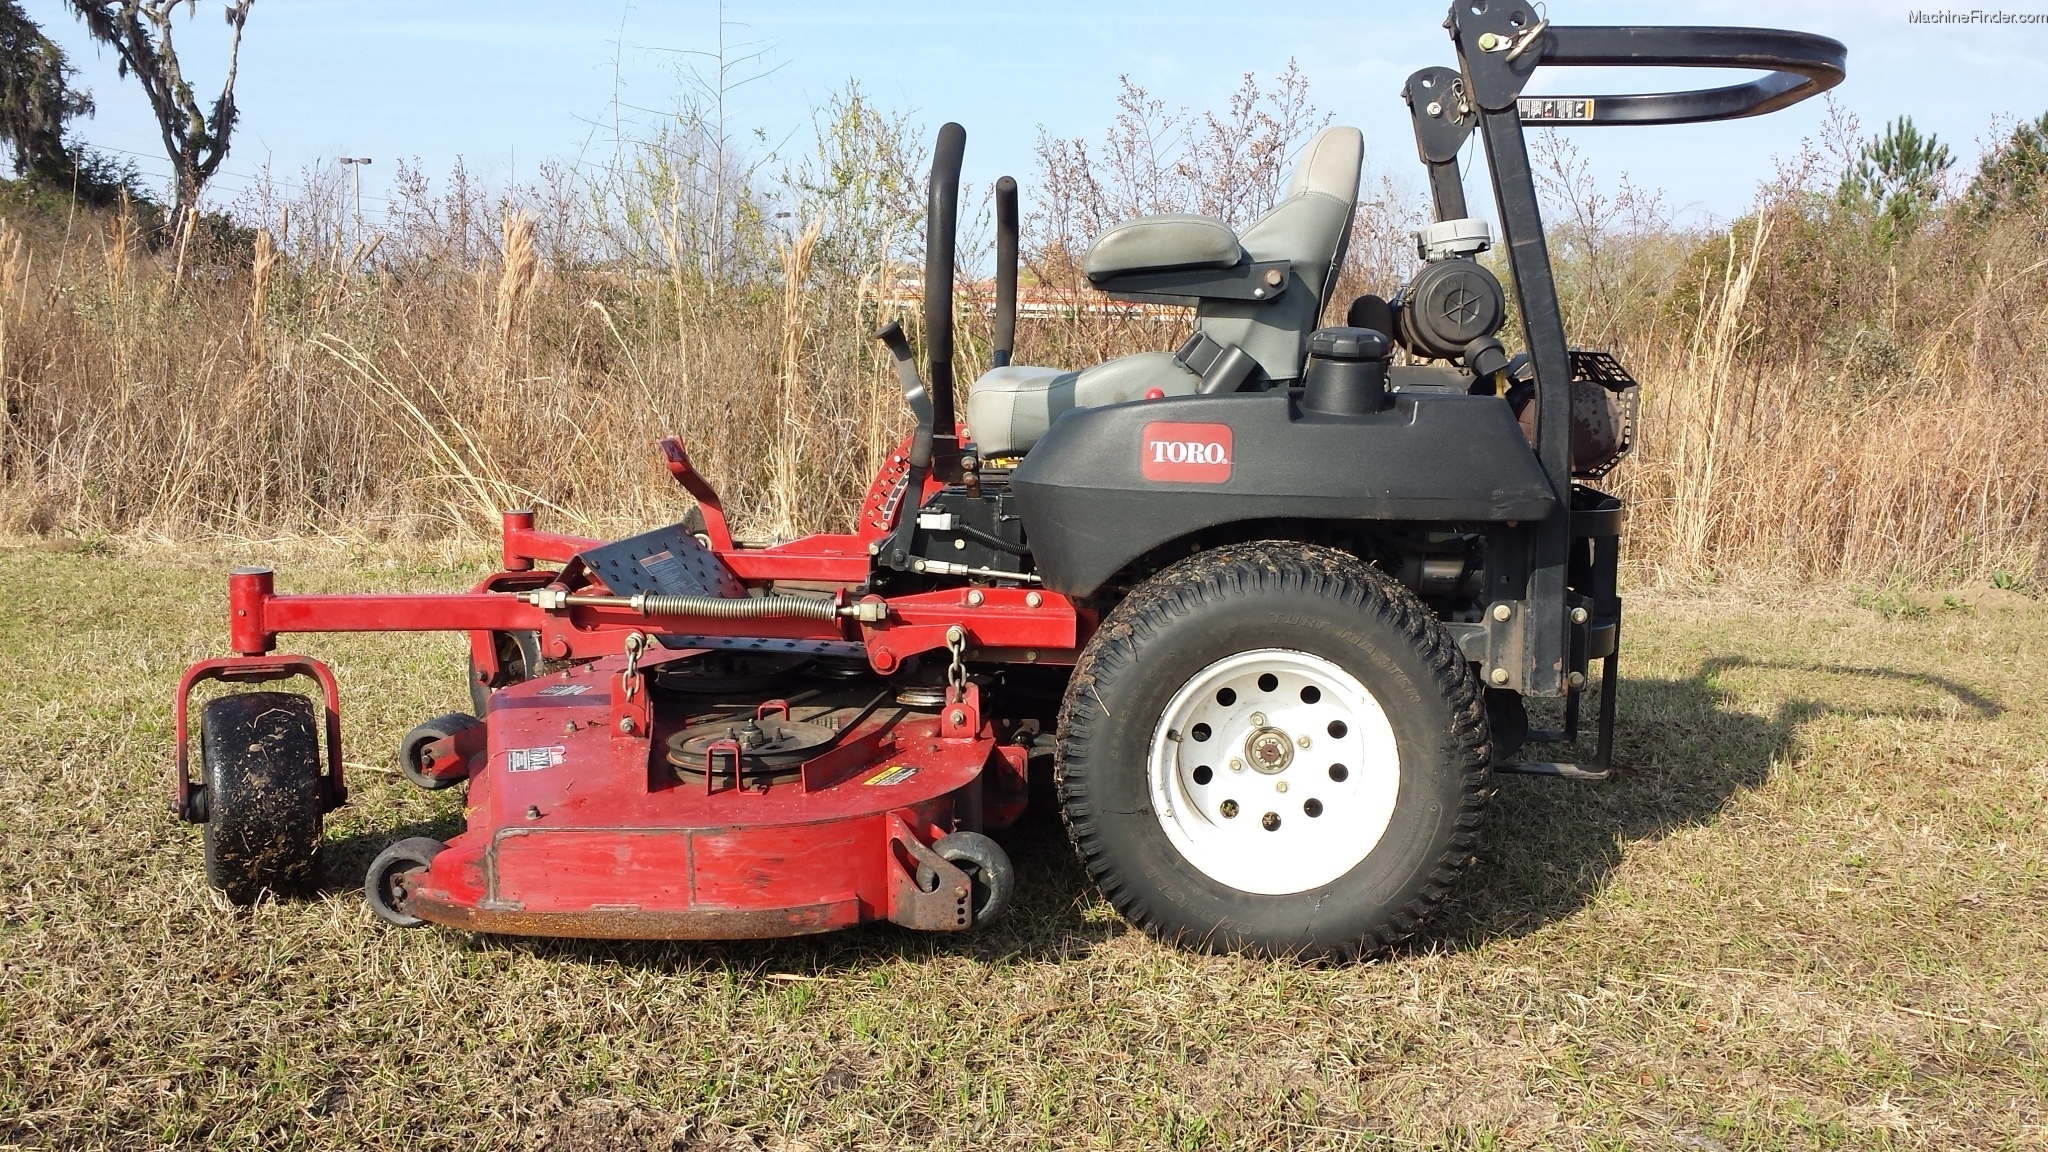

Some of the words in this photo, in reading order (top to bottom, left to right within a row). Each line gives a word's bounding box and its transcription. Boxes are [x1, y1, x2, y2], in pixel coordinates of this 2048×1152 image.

[1269, 614, 1332, 631] TURF
[1340, 629, 1422, 703] MASTER
[1144, 865, 1254, 936] CARLISLE
